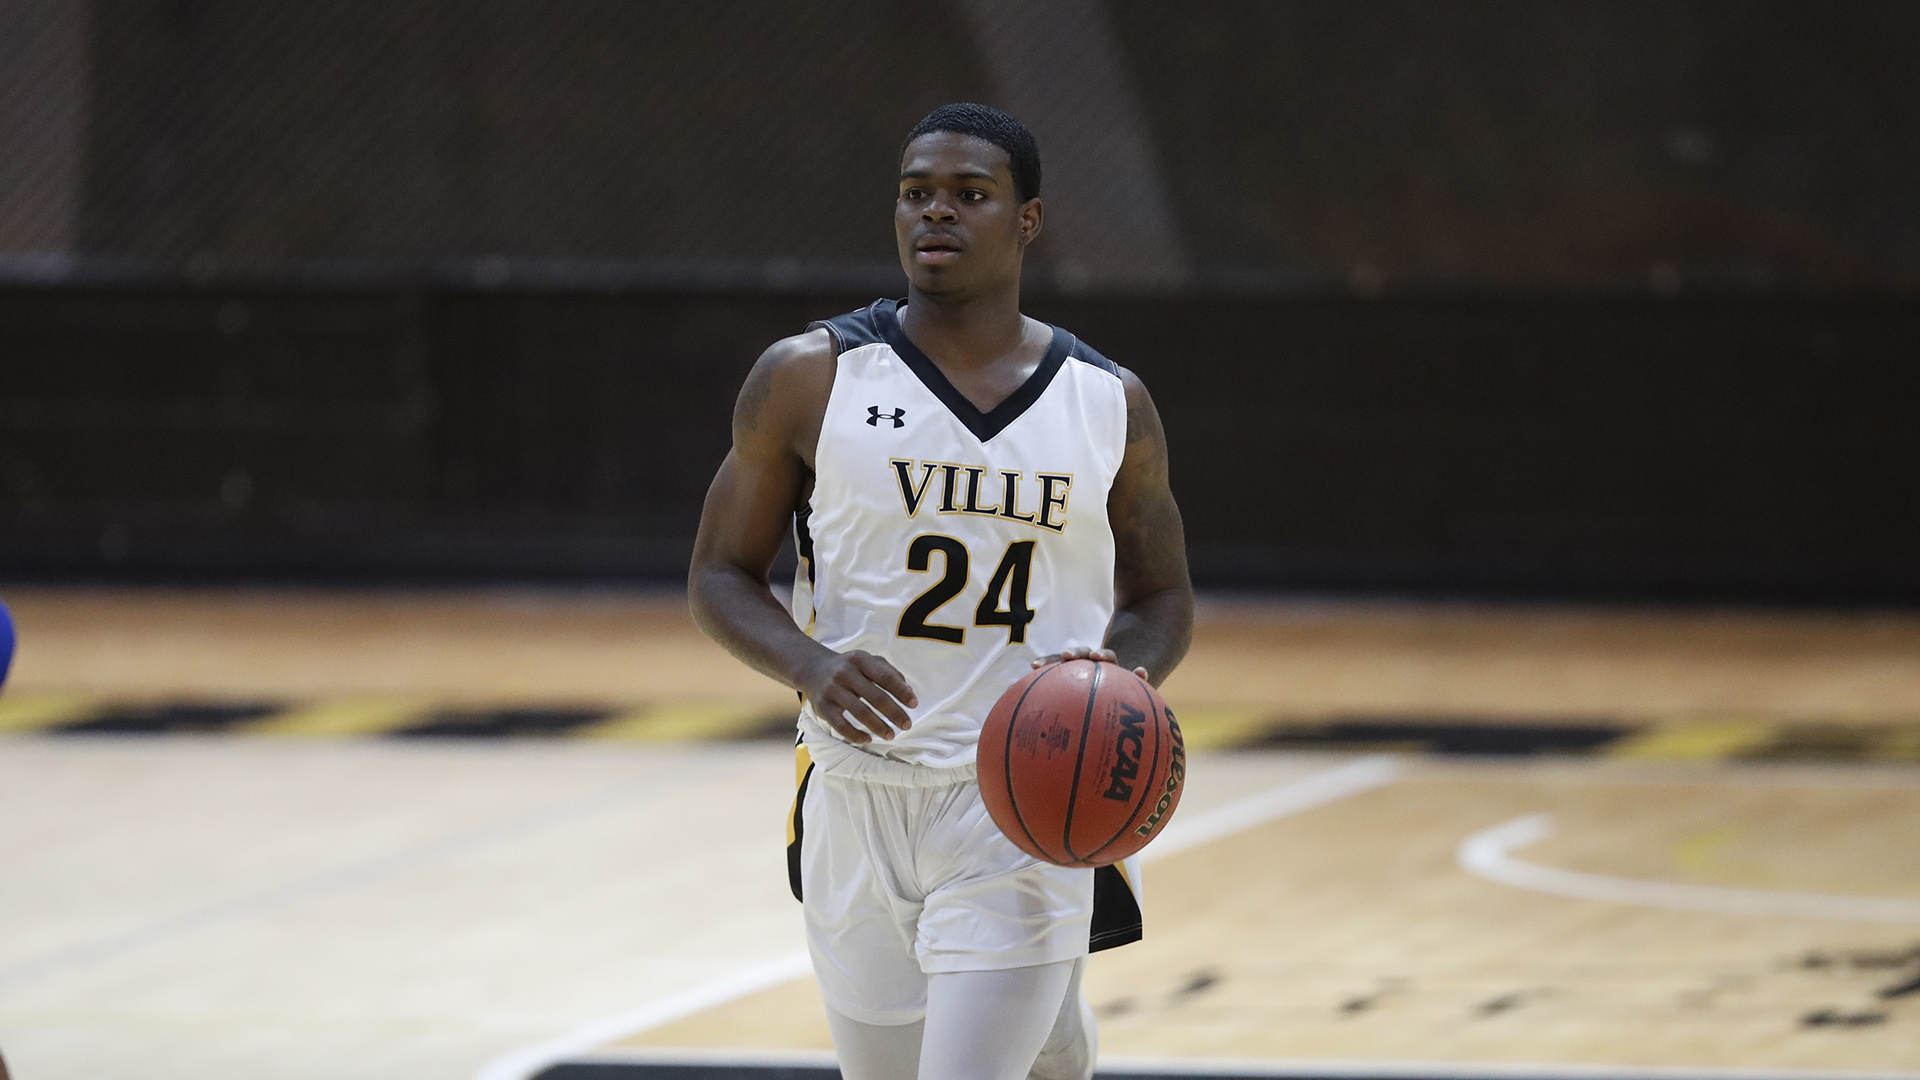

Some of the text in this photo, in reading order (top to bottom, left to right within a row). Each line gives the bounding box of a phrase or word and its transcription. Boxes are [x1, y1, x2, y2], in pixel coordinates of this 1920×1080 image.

[889, 457, 1073, 535] VILLE
[896, 532, 1038, 646] 24
[1103, 702, 1146, 803] NCAA
